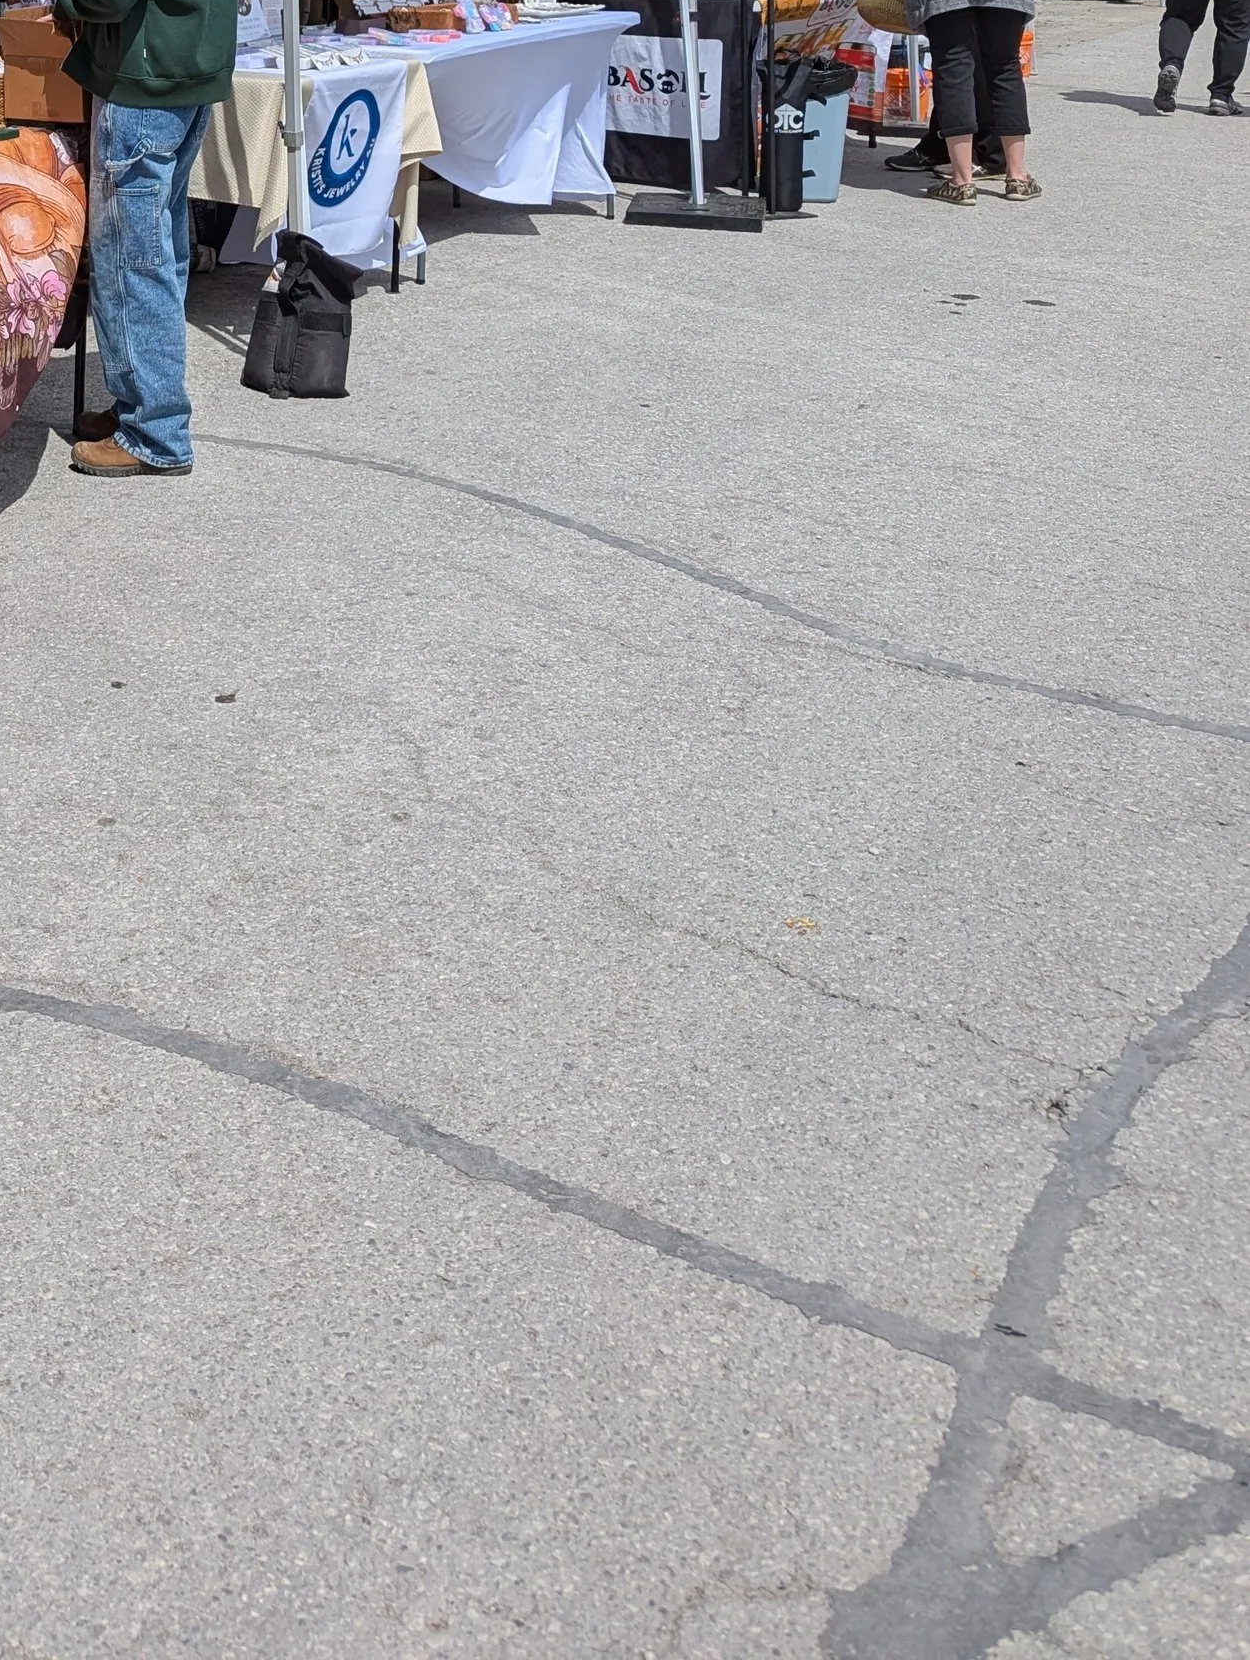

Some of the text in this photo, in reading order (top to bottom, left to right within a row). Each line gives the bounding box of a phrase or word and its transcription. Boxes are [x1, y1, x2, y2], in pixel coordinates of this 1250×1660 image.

[607, 93, 707, 109] HE TASTE OF LE
[323, 161, 365, 199] JEWELRY
